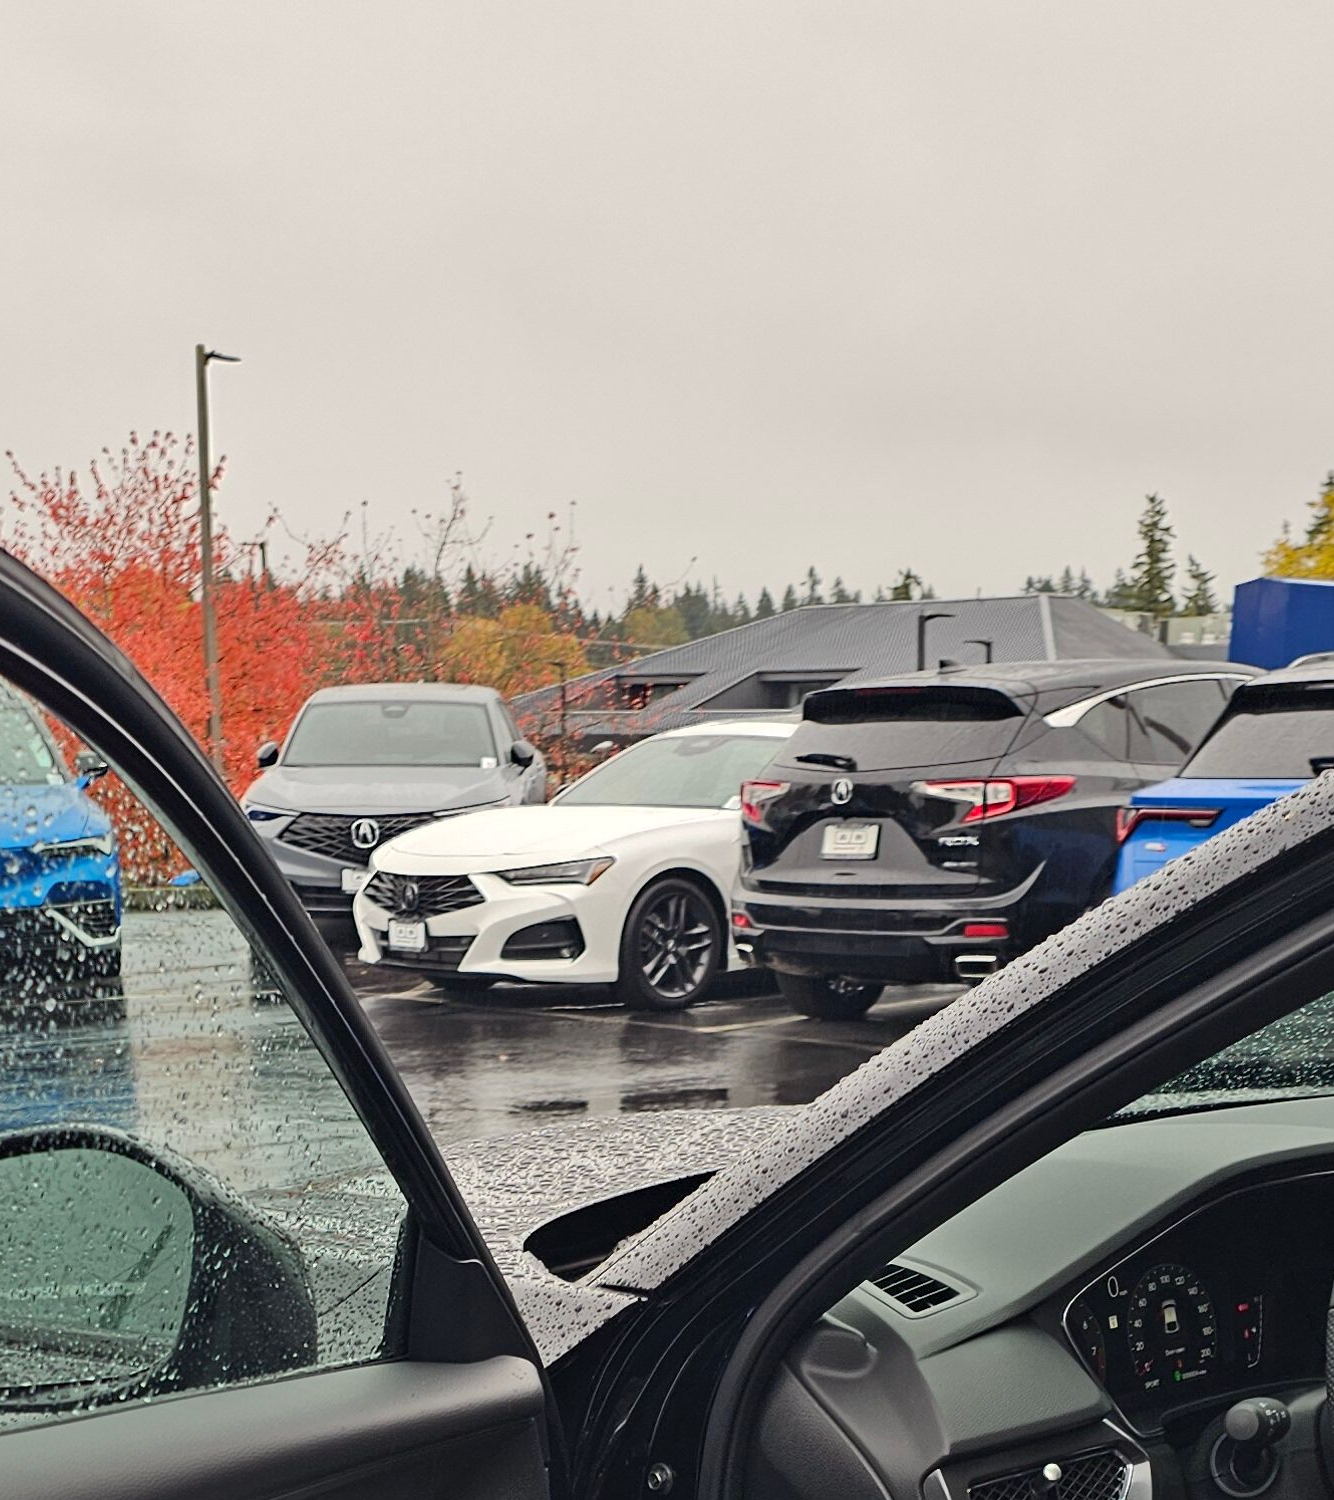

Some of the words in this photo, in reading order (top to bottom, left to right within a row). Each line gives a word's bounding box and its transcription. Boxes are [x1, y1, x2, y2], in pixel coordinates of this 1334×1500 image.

[1107, 1276, 1119, 1298] 0
[1148, 1282, 1157, 1292] 80
[1138, 1298, 1147, 1308] 60
[1133, 1318, 1143, 1328] 40
[1135, 1341, 1145, 1352] 20
